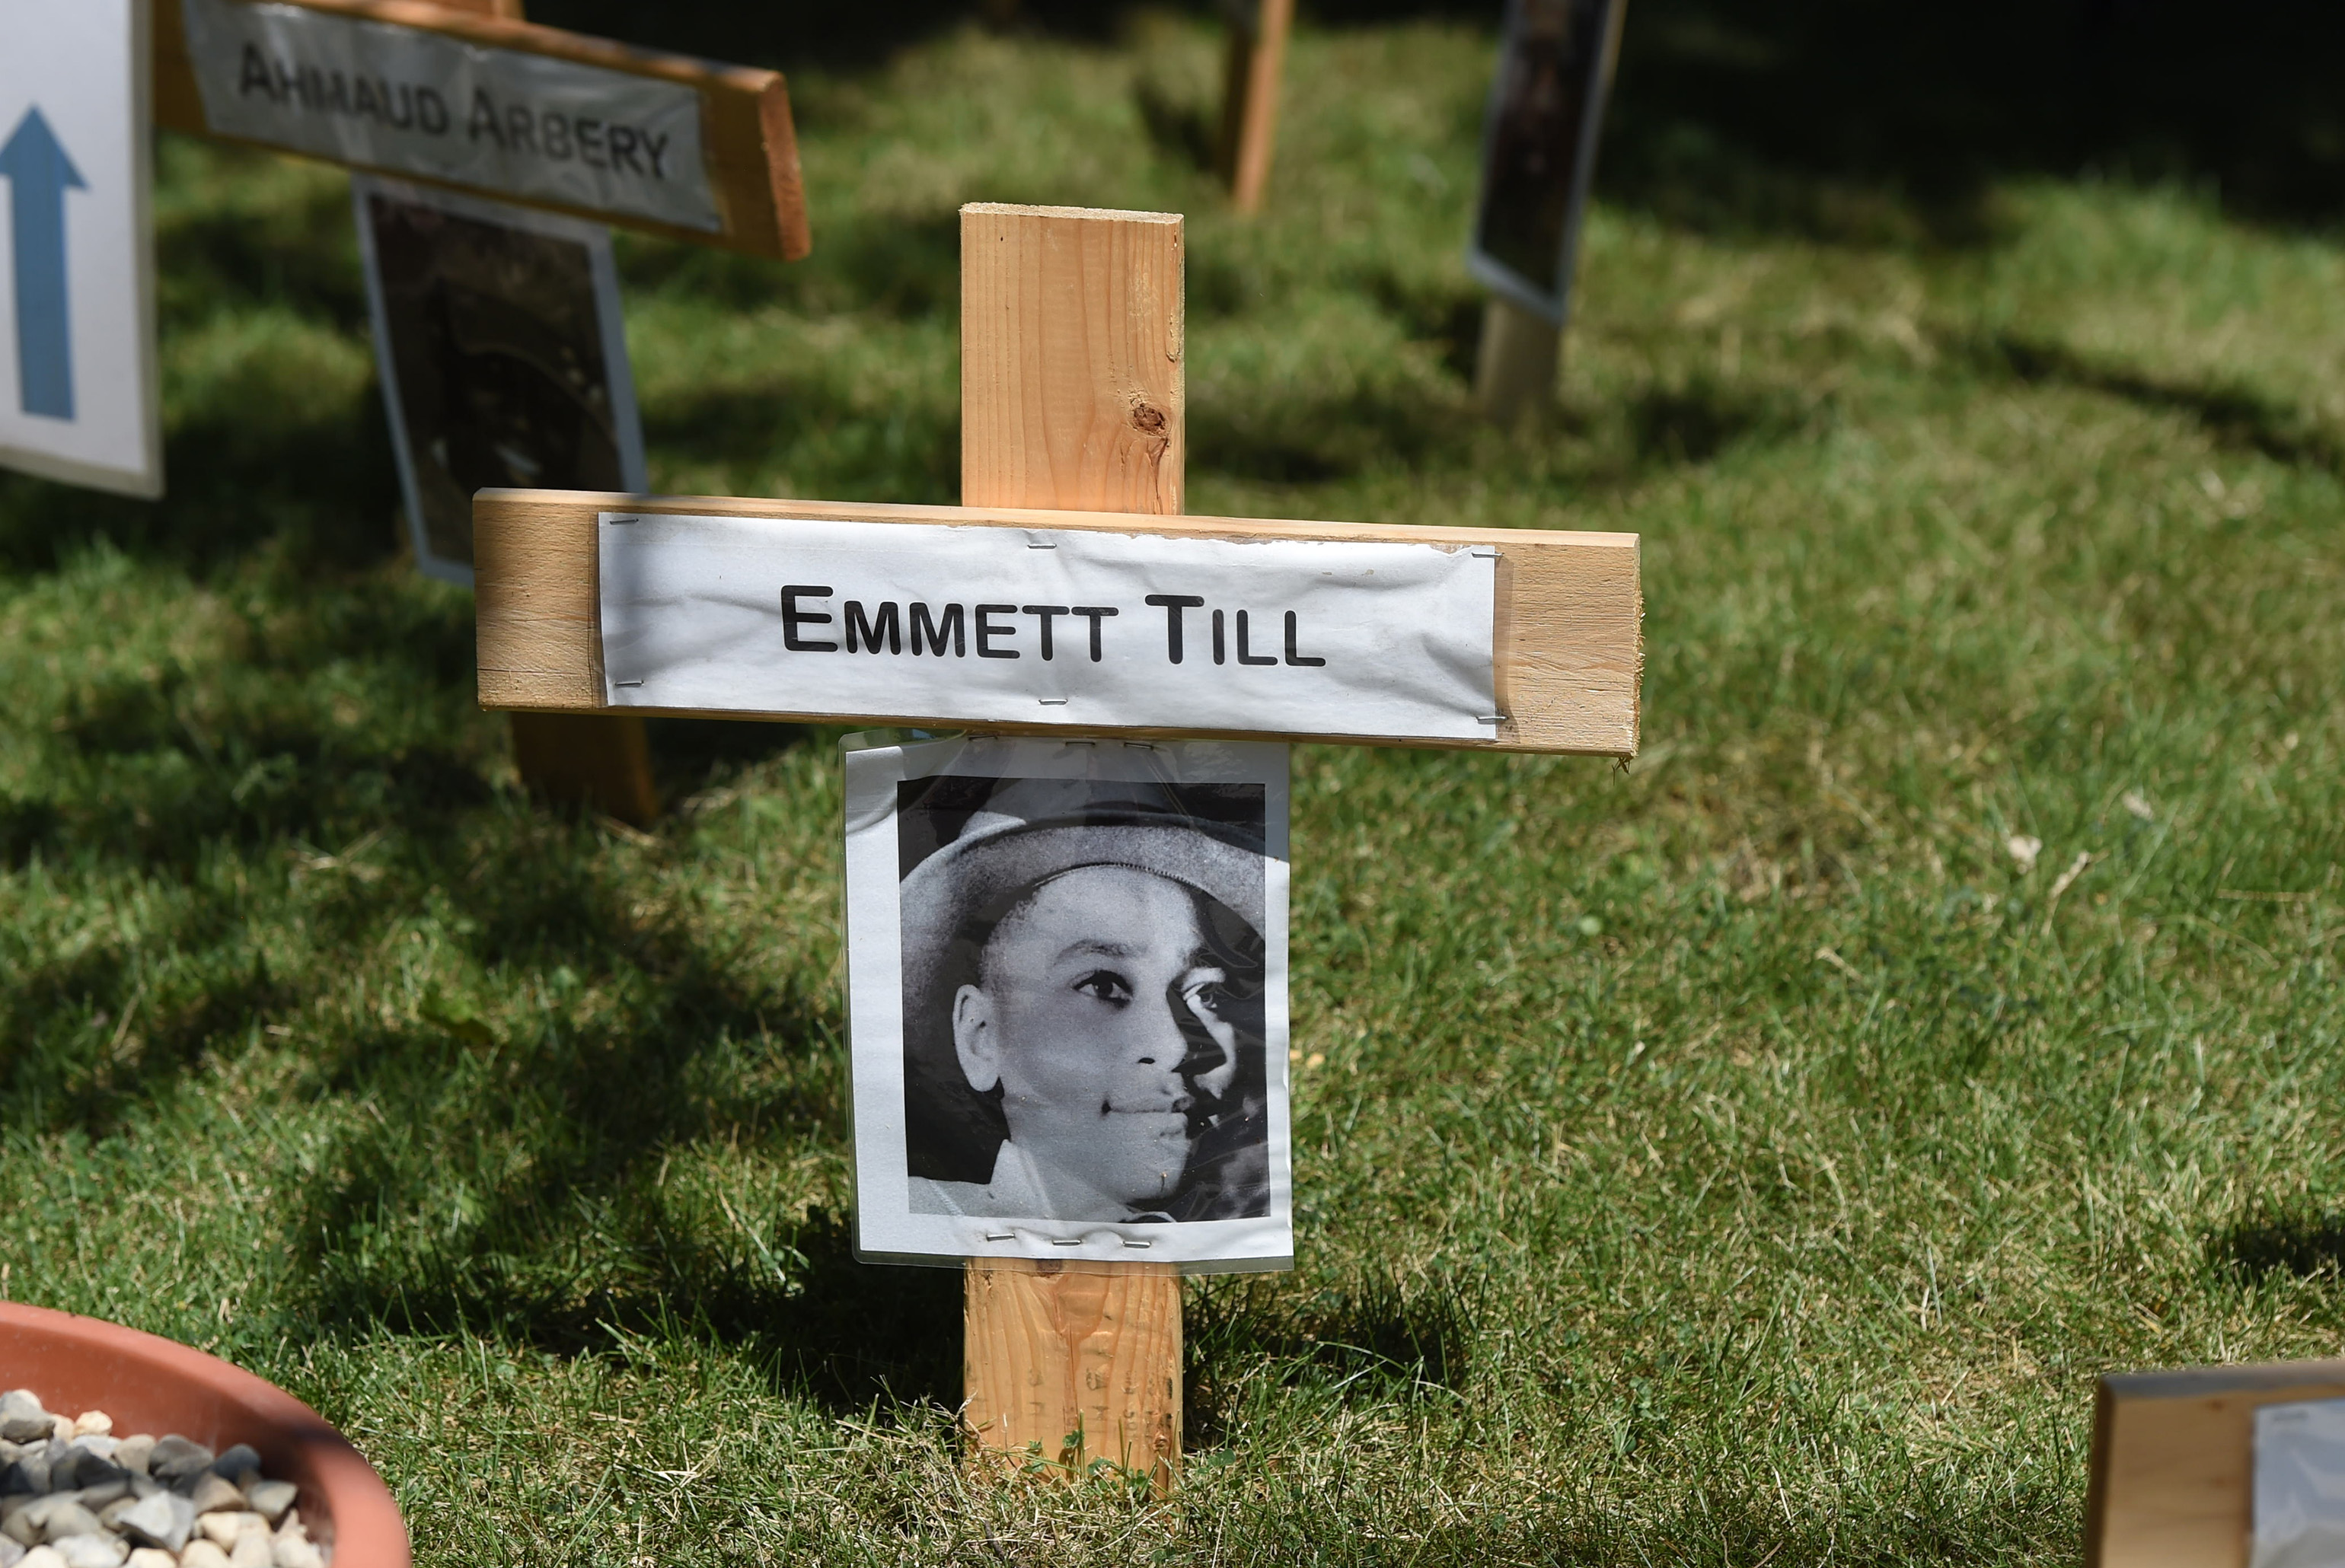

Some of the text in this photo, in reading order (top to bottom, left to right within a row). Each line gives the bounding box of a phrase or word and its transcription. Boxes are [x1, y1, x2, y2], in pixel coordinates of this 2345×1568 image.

[239, 42, 670, 180] AHMAUD ARBERY
[780, 585, 1327, 667] EMMETT TILL
